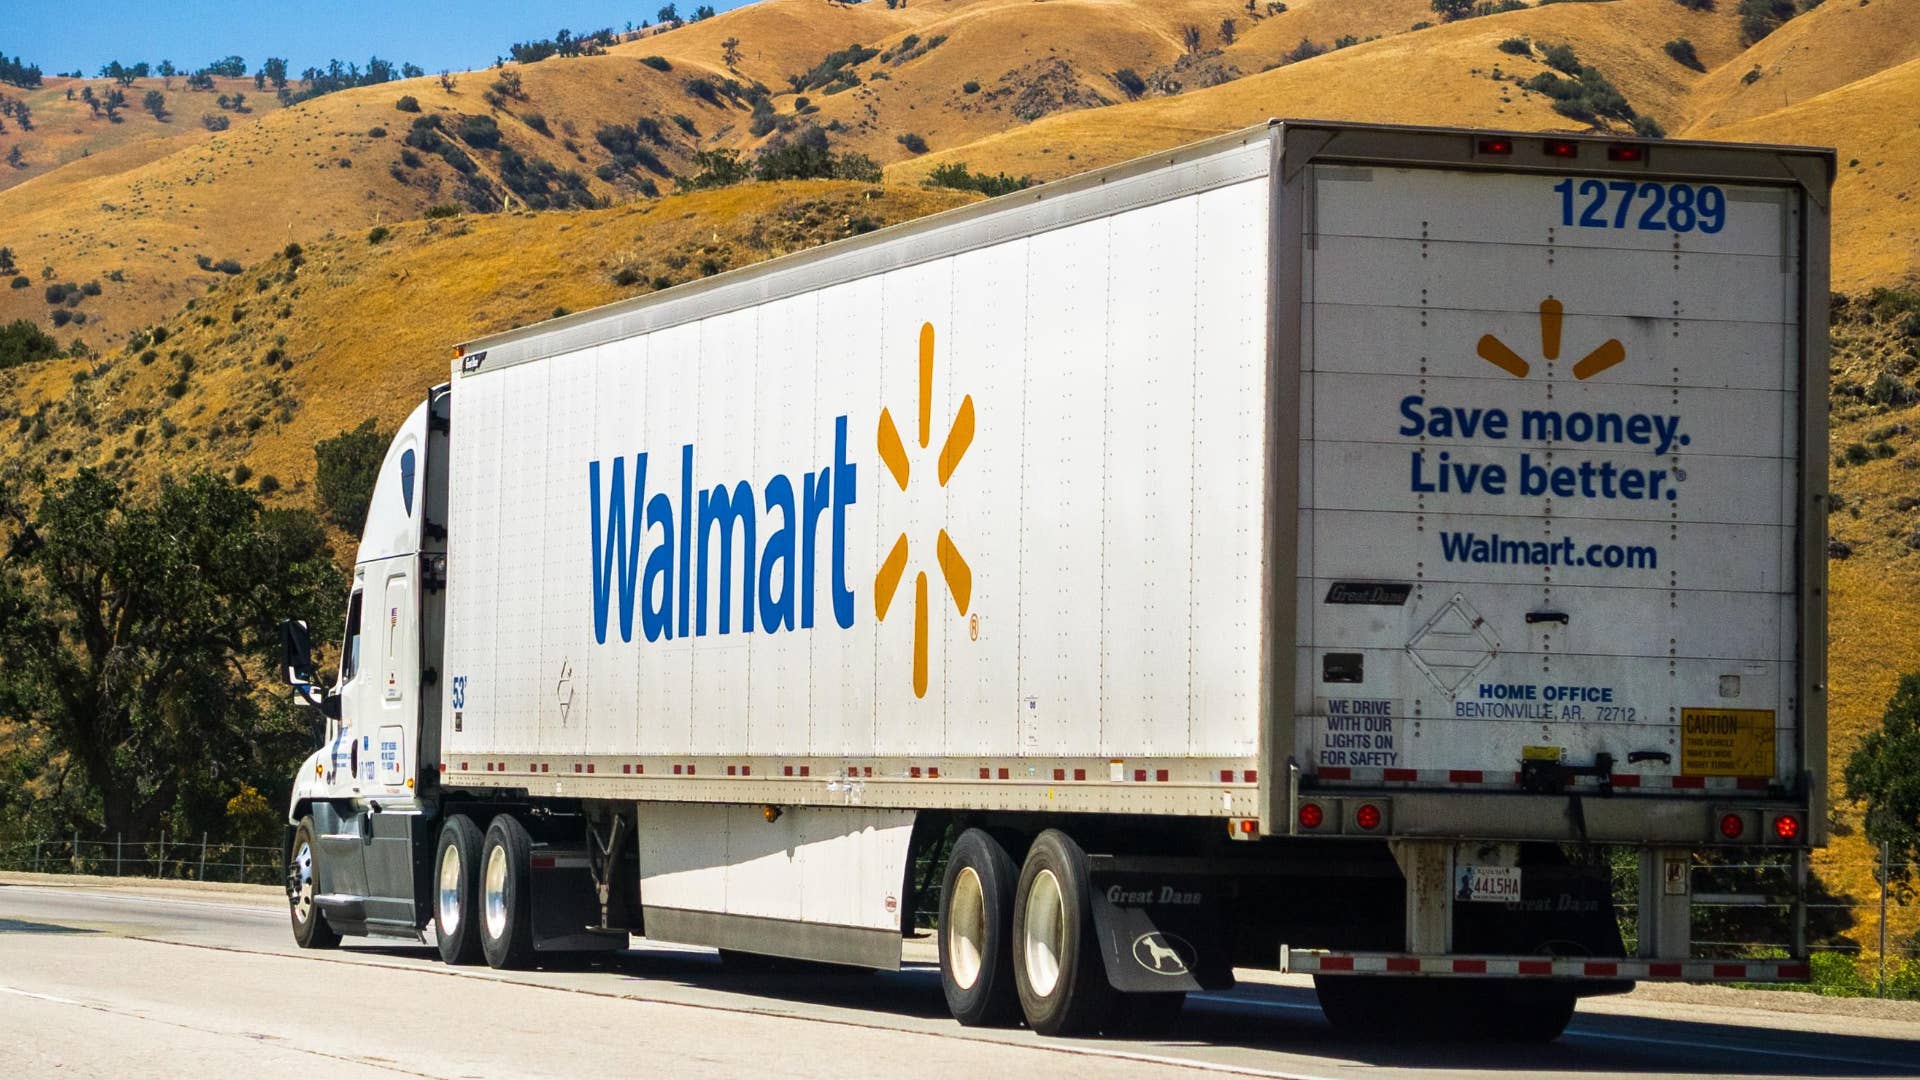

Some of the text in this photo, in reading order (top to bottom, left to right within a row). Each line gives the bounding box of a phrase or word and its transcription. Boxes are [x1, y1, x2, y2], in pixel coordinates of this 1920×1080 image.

[1553, 178, 1726, 234] 127289
[1399, 395, 1691, 456] Save money.
[1411, 452, 1507, 496] Live
[589, 414, 857, 645] Walmart
[1439, 531, 1657, 569] Walmart.com
[1479, 684, 1614, 702] HOME OFFICE
[1328, 699, 1392, 715] WE DRIVE
[1456, 702, 1636, 722] BENTONVILLE, AR. 72712
[1327, 716, 1392, 732] WITH OUR
[1686, 714, 1738, 735] CAUTION
[1325, 733, 1393, 750] LIGHTS ON
[1320, 750, 1398, 767] FOR SAFETY
[1107, 884, 1153, 903] Great
[1473, 877, 1519, 895] 4415HA
